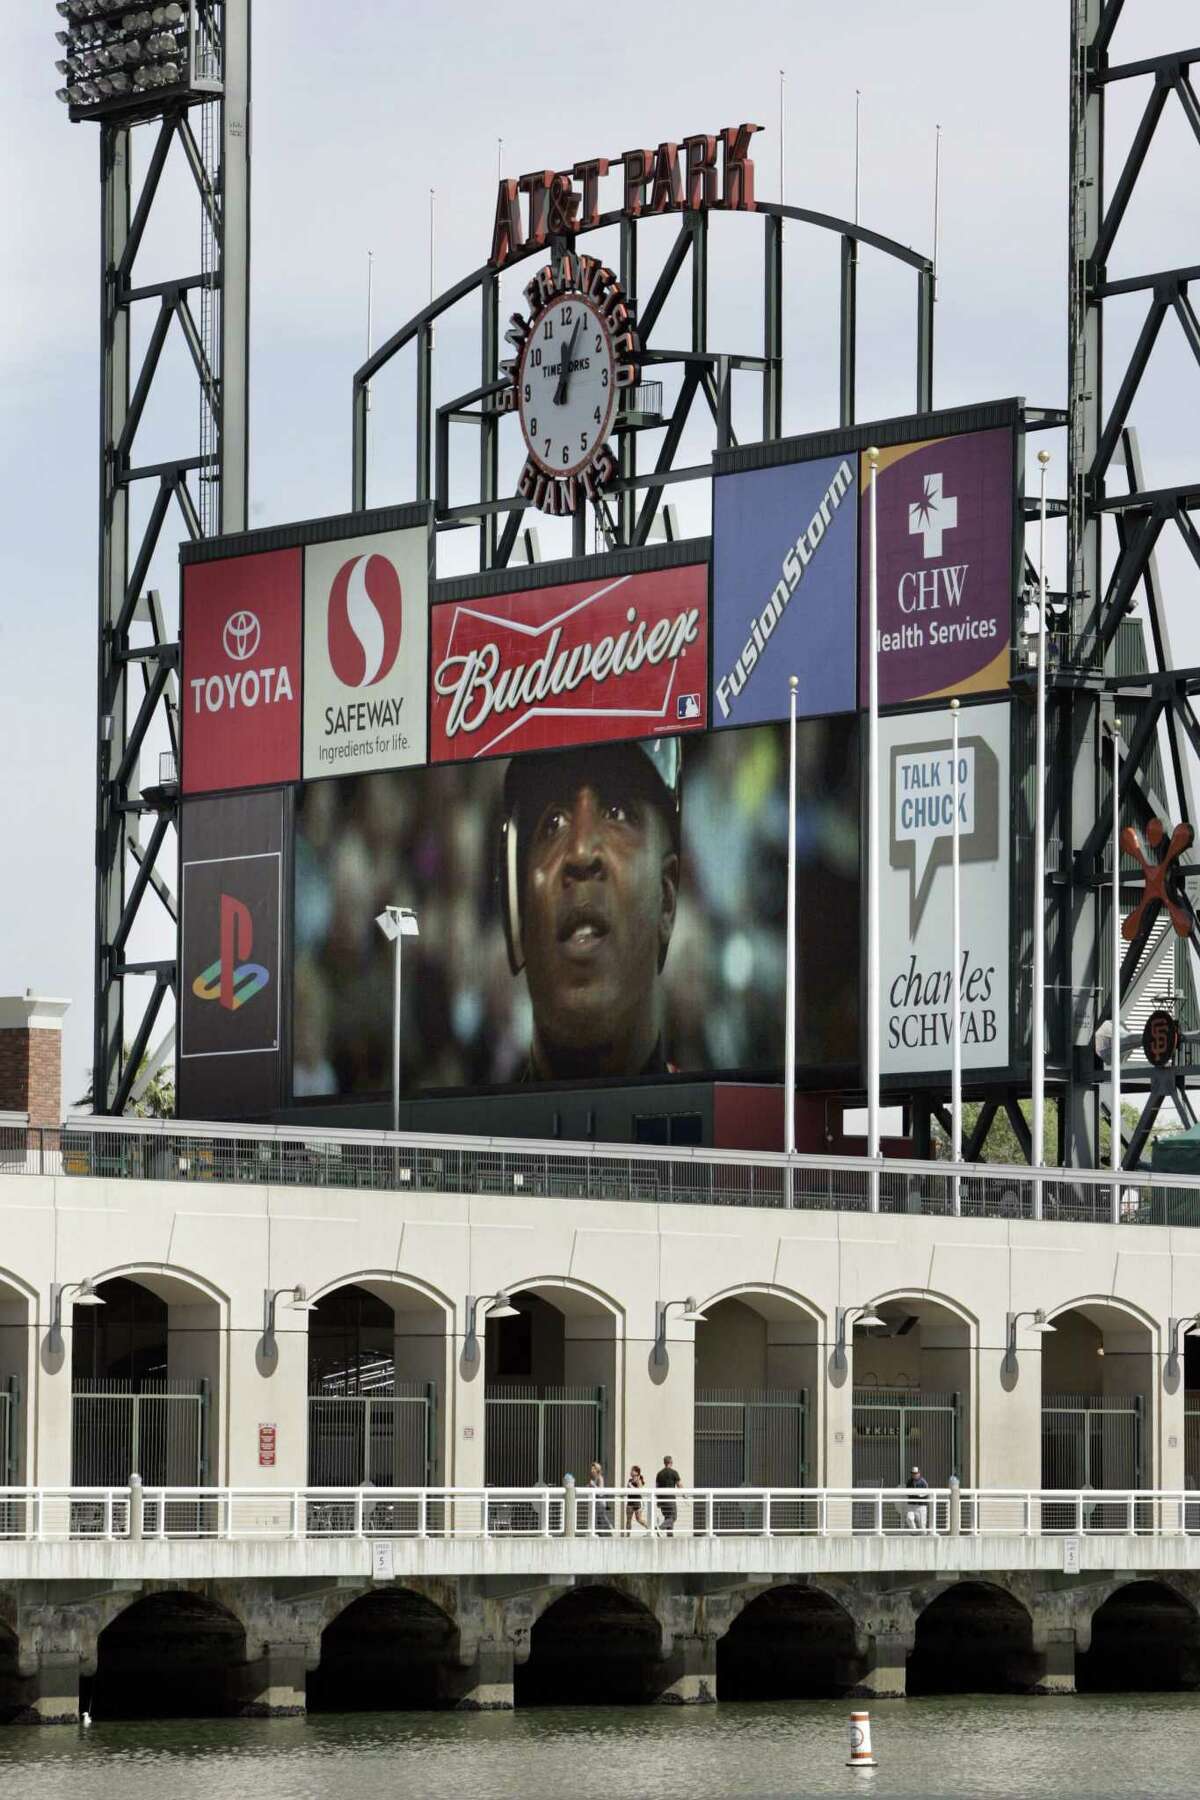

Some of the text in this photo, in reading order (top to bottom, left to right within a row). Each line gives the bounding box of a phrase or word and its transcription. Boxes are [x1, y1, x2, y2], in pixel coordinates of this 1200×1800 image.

[488, 123, 765, 267] AT&T PARK
[561, 307, 573, 326] 12
[583, 312, 588, 331] 1
[495, 252, 641, 411] SAN FRANCISCO
[544, 320, 553, 340] 11
[595, 334, 602, 353] 2
[530, 348, 542, 368] 10
[542, 358, 590, 378] TIMEORKS
[601, 368, 609, 387] 3
[524, 384, 531, 403] 9
[593, 405, 601, 424] 4
[530, 418, 537, 436] 8
[545, 438, 552, 457] 7
[581, 432, 588, 451] 5
[562, 446, 569, 464] 6
[518, 443, 619, 516] GIANTS
[715, 460, 853, 719] FusionStorm
[898, 564, 969, 614] CHW
[929, 616, 996, 645] Services
[434, 607, 699, 737] Budweiser
[190, 666, 293, 714] TOYOTA
[324, 697, 404, 735] SAFEWAY
[319, 740, 374, 764] Ingredients
[376, 736, 390, 753] for
[901, 758, 968, 790] TALK TO
[901, 792, 967, 829] CHUCK
[890, 950, 995, 1008] charles
